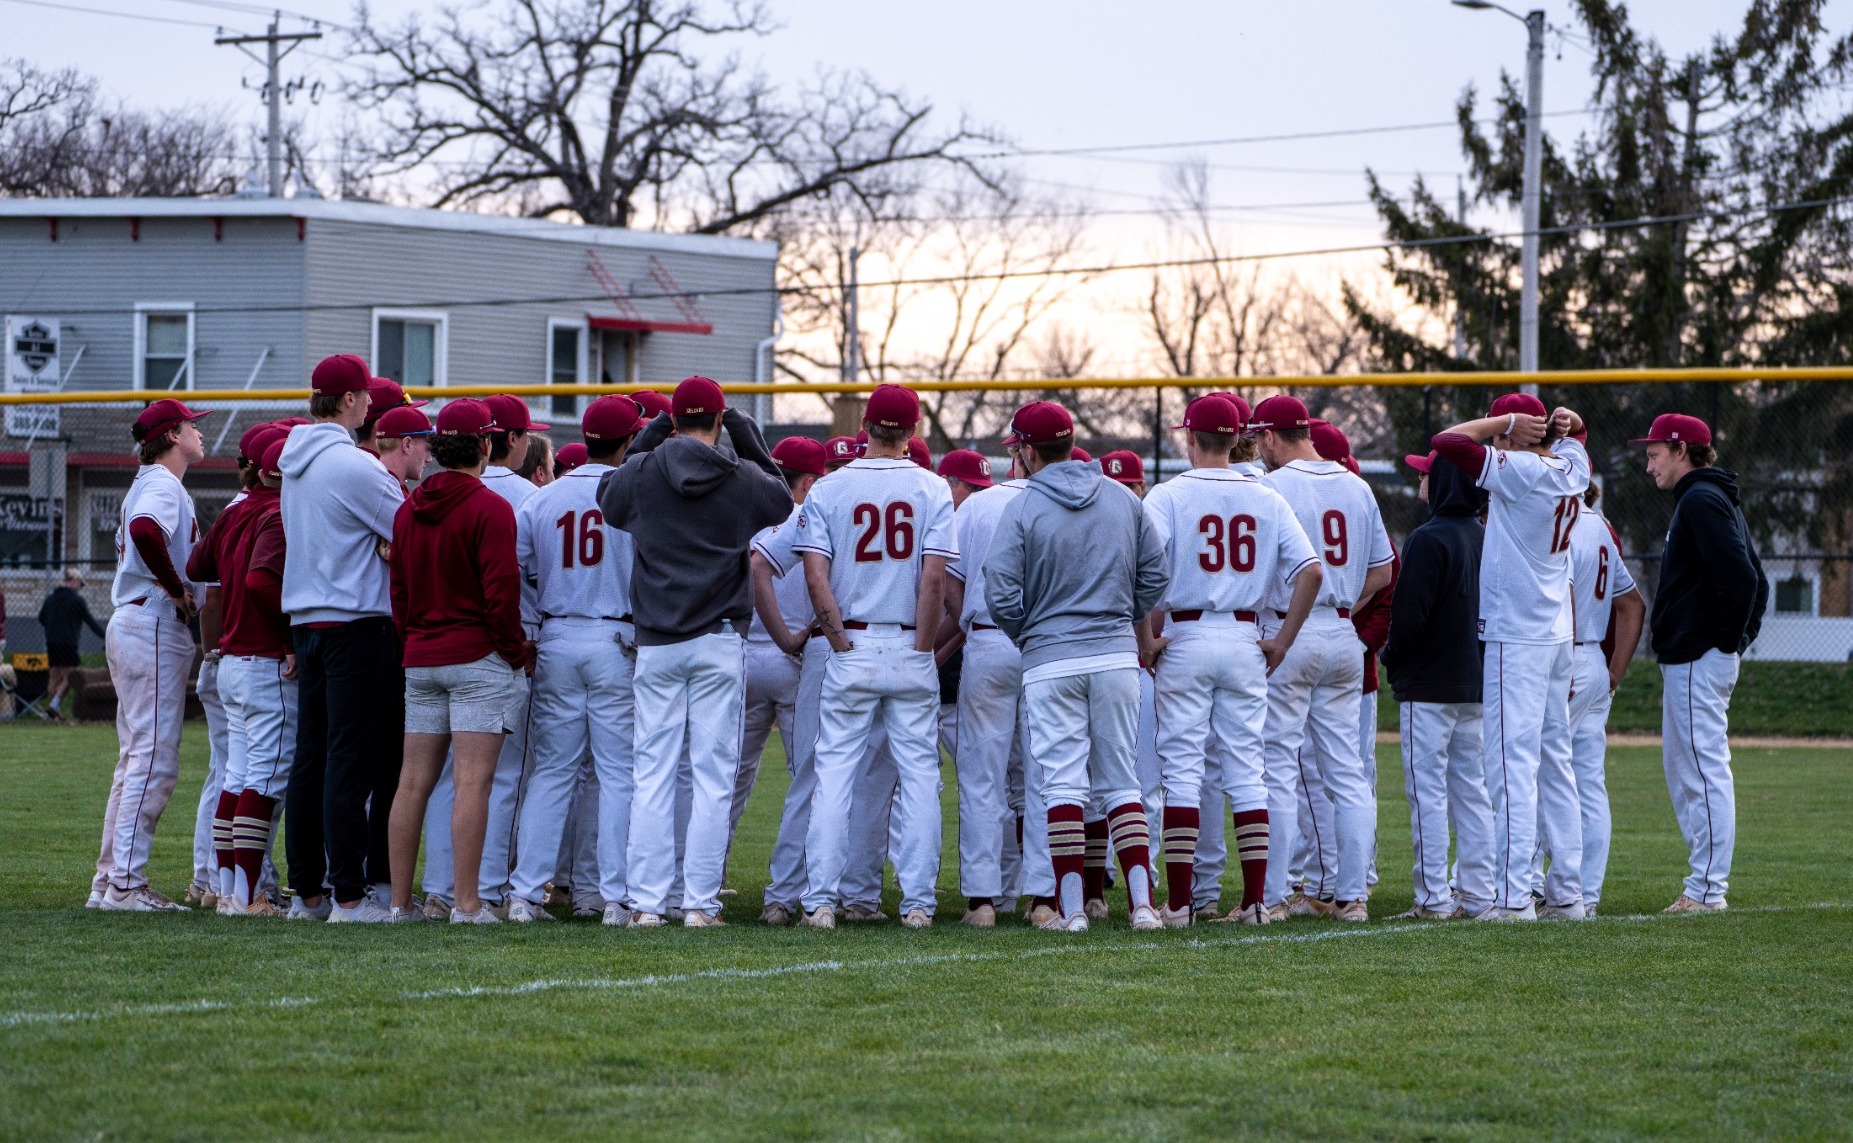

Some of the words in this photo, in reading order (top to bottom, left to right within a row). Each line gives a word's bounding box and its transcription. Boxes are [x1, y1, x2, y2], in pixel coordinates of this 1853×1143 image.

[556, 508, 605, 570] 16
[852, 500, 915, 563] 26
[1199, 513, 1257, 573] 36
[1322, 509, 1349, 568] 9
[1550, 495, 1581, 555] 12
[1594, 544, 1609, 601] 6
